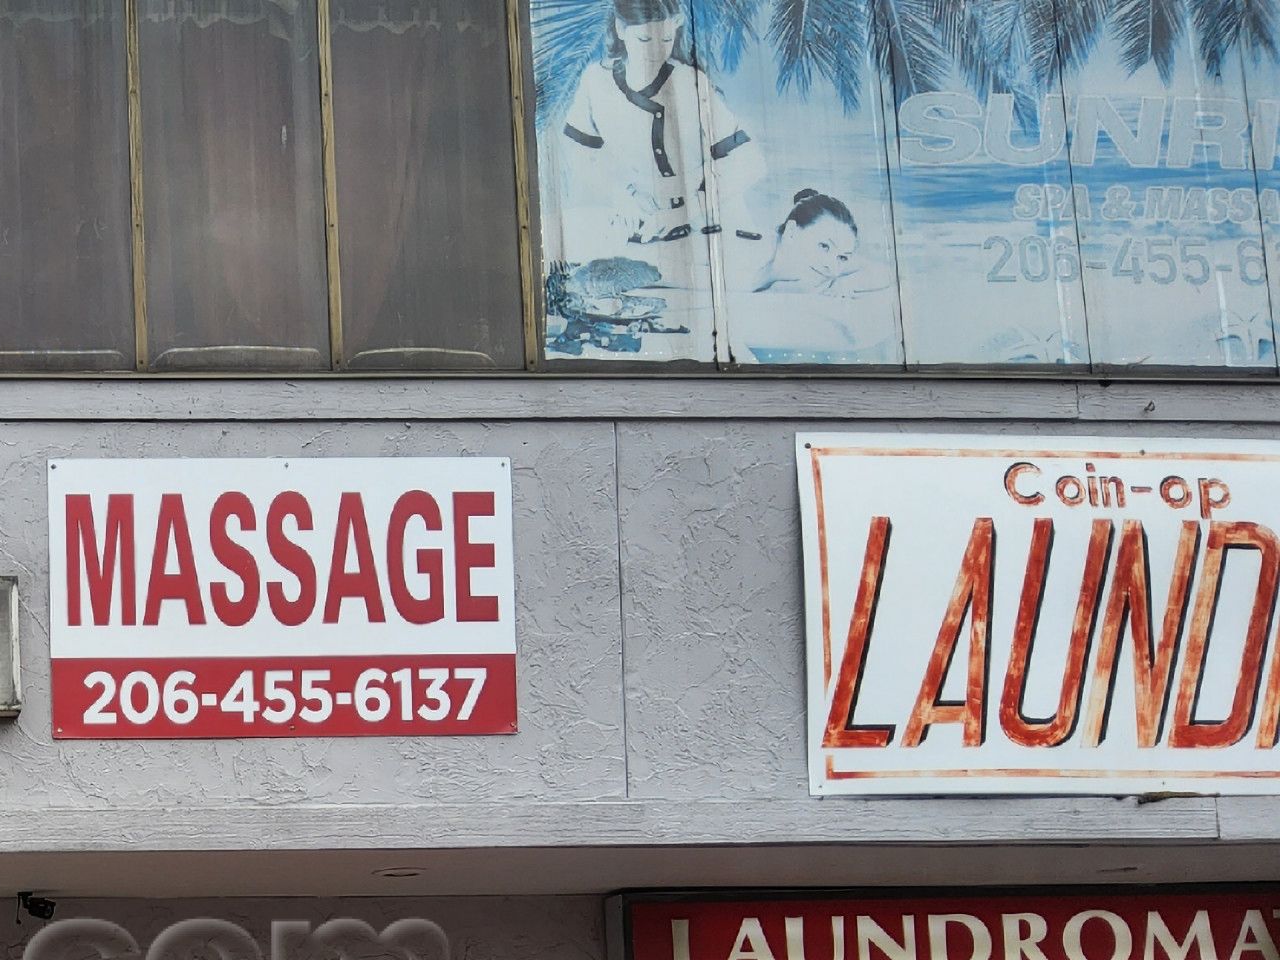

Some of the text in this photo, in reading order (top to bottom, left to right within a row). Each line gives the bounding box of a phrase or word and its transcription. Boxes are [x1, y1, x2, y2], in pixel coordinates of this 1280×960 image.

[1013, 183, 1091, 221] SPA
[1102, 185, 1136, 220] &
[982, 235, 1280, 286] 206-455-6
[1004, 462, 1231, 519] Coin-op
[65, 490, 499, 626] MASSAGE
[83, 668, 487, 725] 206-455-6137
